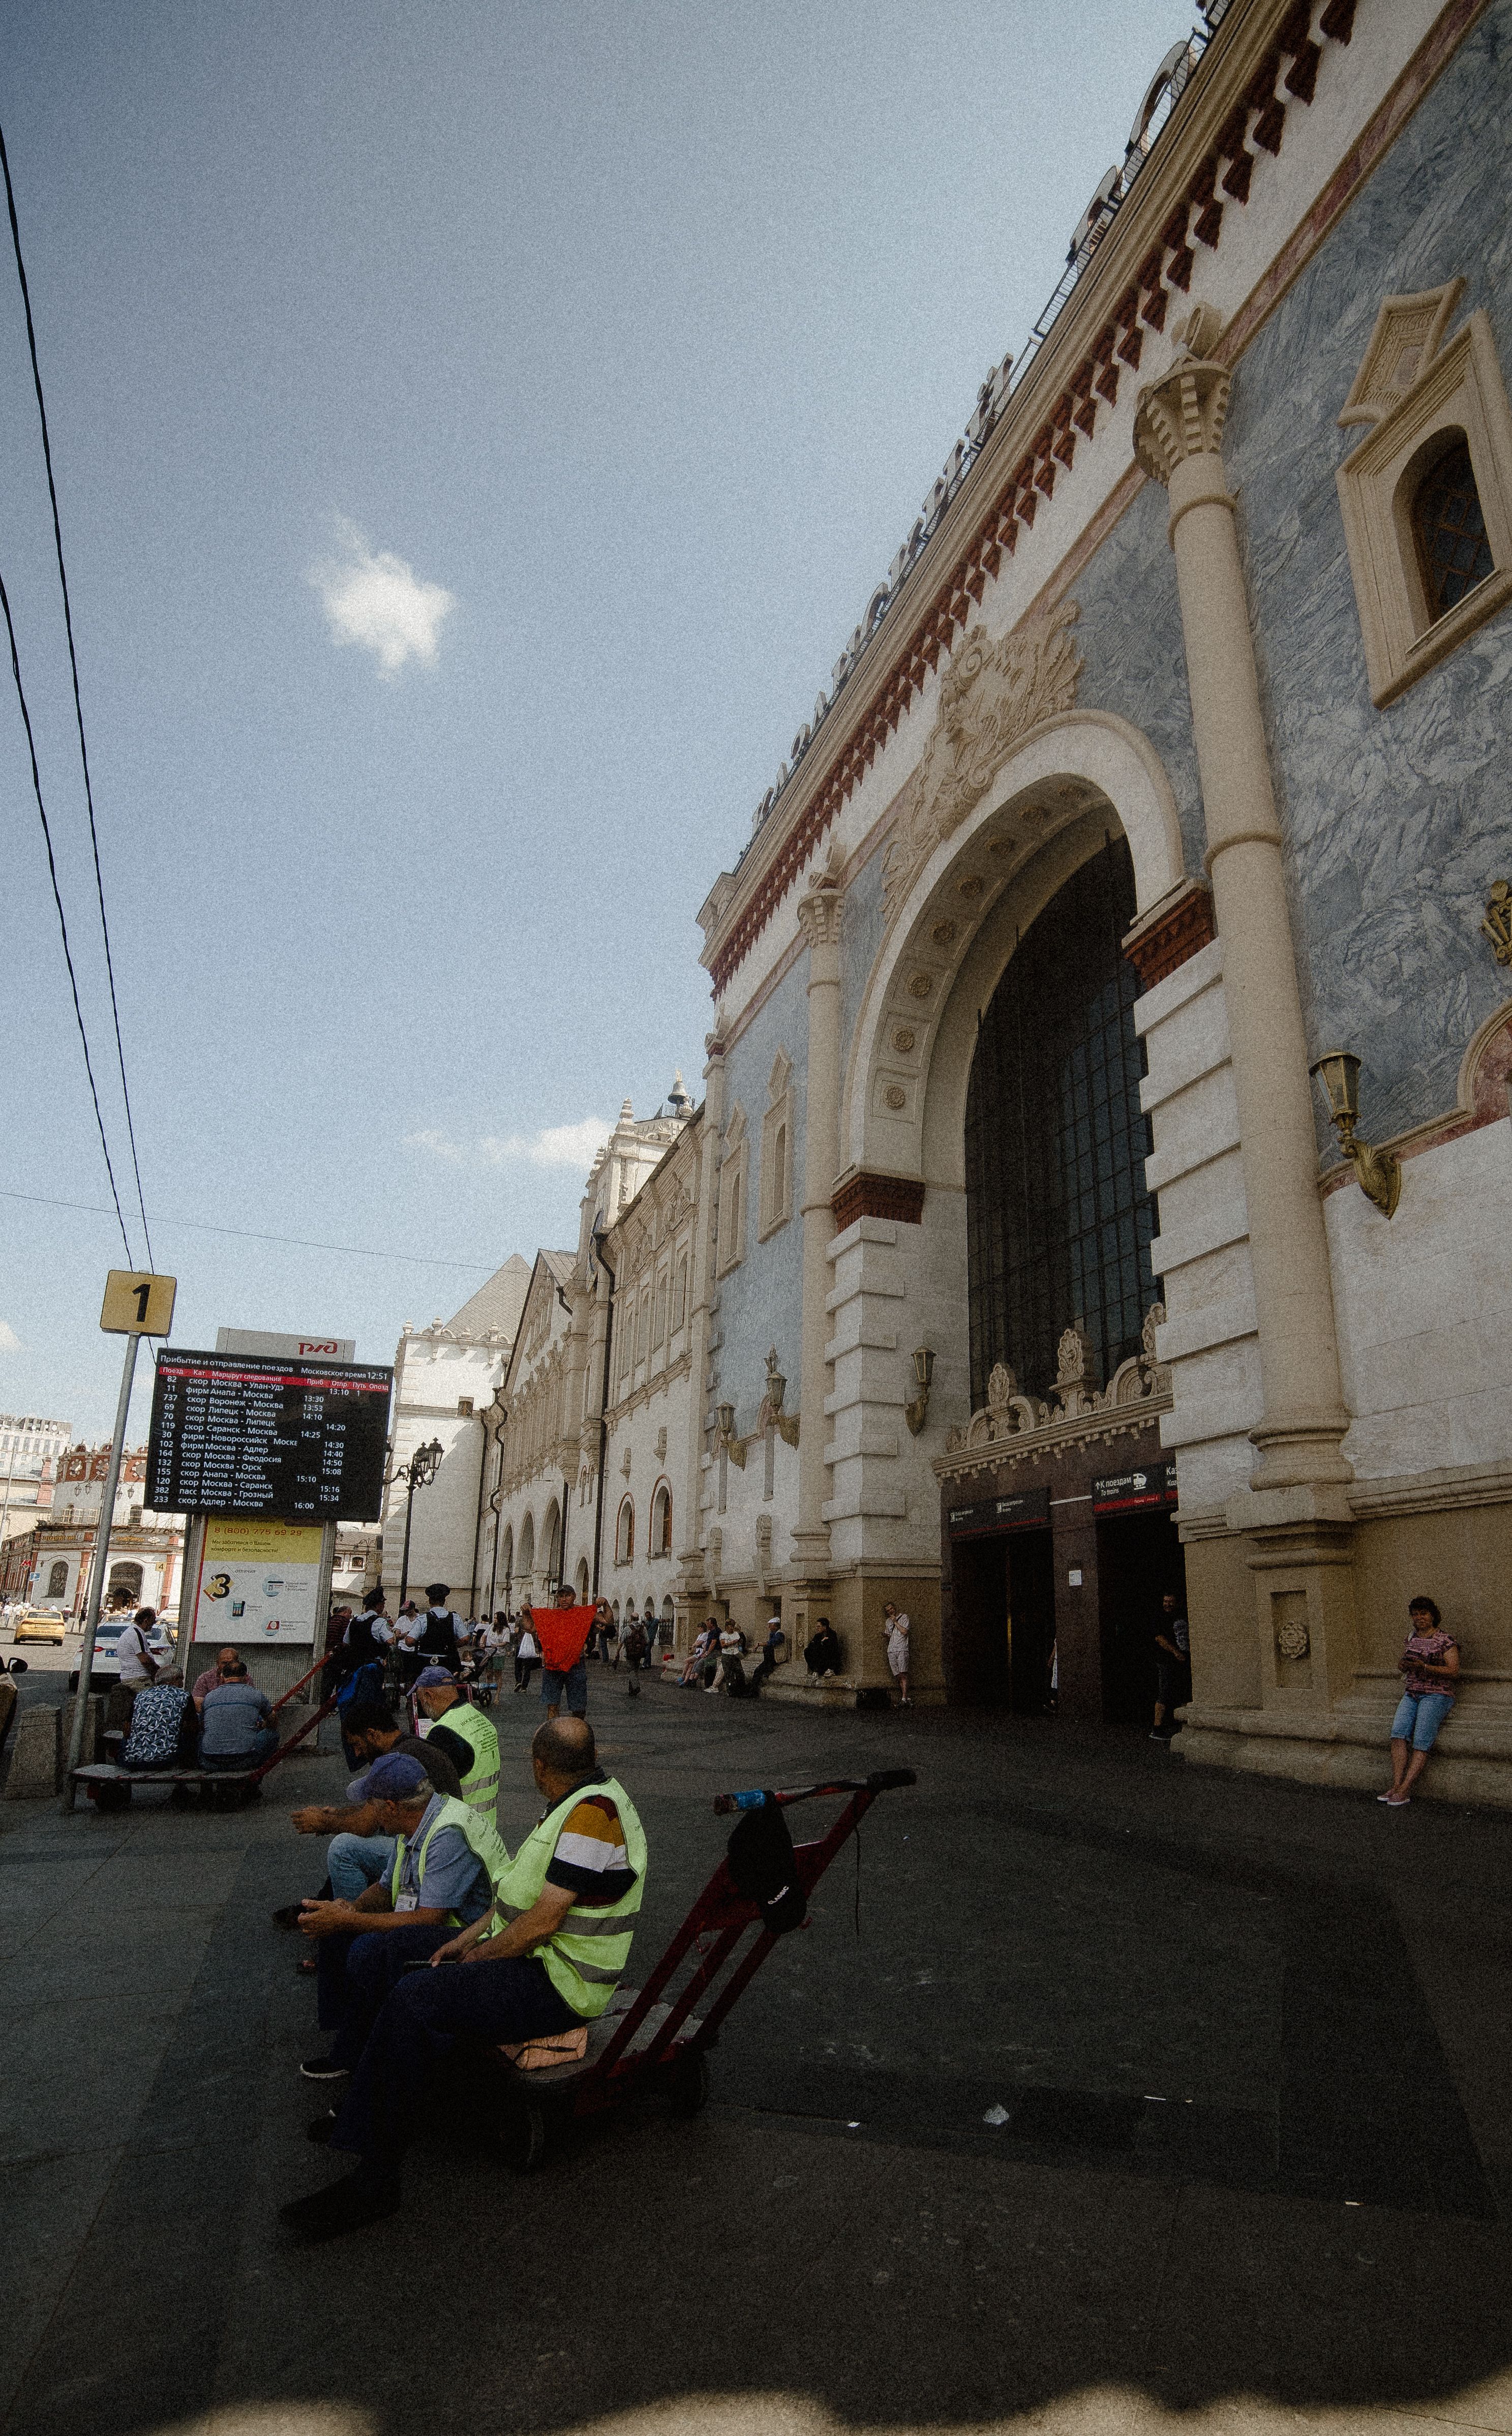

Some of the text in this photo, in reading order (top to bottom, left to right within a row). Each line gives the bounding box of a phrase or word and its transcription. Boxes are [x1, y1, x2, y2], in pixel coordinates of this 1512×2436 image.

[132, 1284, 151, 1322] 1
[161, 1355, 201, 1365] Прибытие
[209, 1361, 260, 1369] отправление
[301, 1368, 344, 1376] Московское
[368, 1372, 387, 1380] 12:51
[212, 1371, 243, 1380] Маршрут
[189, 1378, 208, 1387] скор
[211, 1379, 241, 1388] Москва
[250, 1382, 284, 1391] Улан-Удэ
[186, 1387, 209, 1395] фирм
[210, 1388, 235, 1396] Анапа
[243, 1391, 273, 1399] Москва
[187, 1397, 206, 1405] скор
[209, 1397, 246, 1406] Воронеж
[254, 1400, 283, 1408] Москва
[208, 1406, 238, 1416] Липецк
[246, 1409, 276, 1417] Москва
[208, 1416, 238, 1424] Москва
[246, 1418, 275, 1427] Липецк
[207, 1425, 240, 1433] Саранск
[248, 1427, 278, 1435] Москва
[182, 1433, 205, 1441] фирм
[211, 1434, 267, 1444] Новороссийск
[180, 1442, 204, 1451] фирм
[205, 1443, 235, 1451] Москва
[243, 1446, 268, 1455] Адлер
[204, 1452, 235, 1460] Москва
[243, 1454, 281, 1463] Феодосия
[241, 1464, 261, 1472] Орск
[240, 1482, 273, 1490] Саранск
[1100, 1477, 1131, 1489] К поездам
[239, 1491, 273, 1499] Грозный
[200, 1498, 226, 1507] Адлер
[224, 1527, 249, 1535] (800)
[210, 1574, 231, 1598] 3
[768, 1886, 789, 1904] CLASSIC
